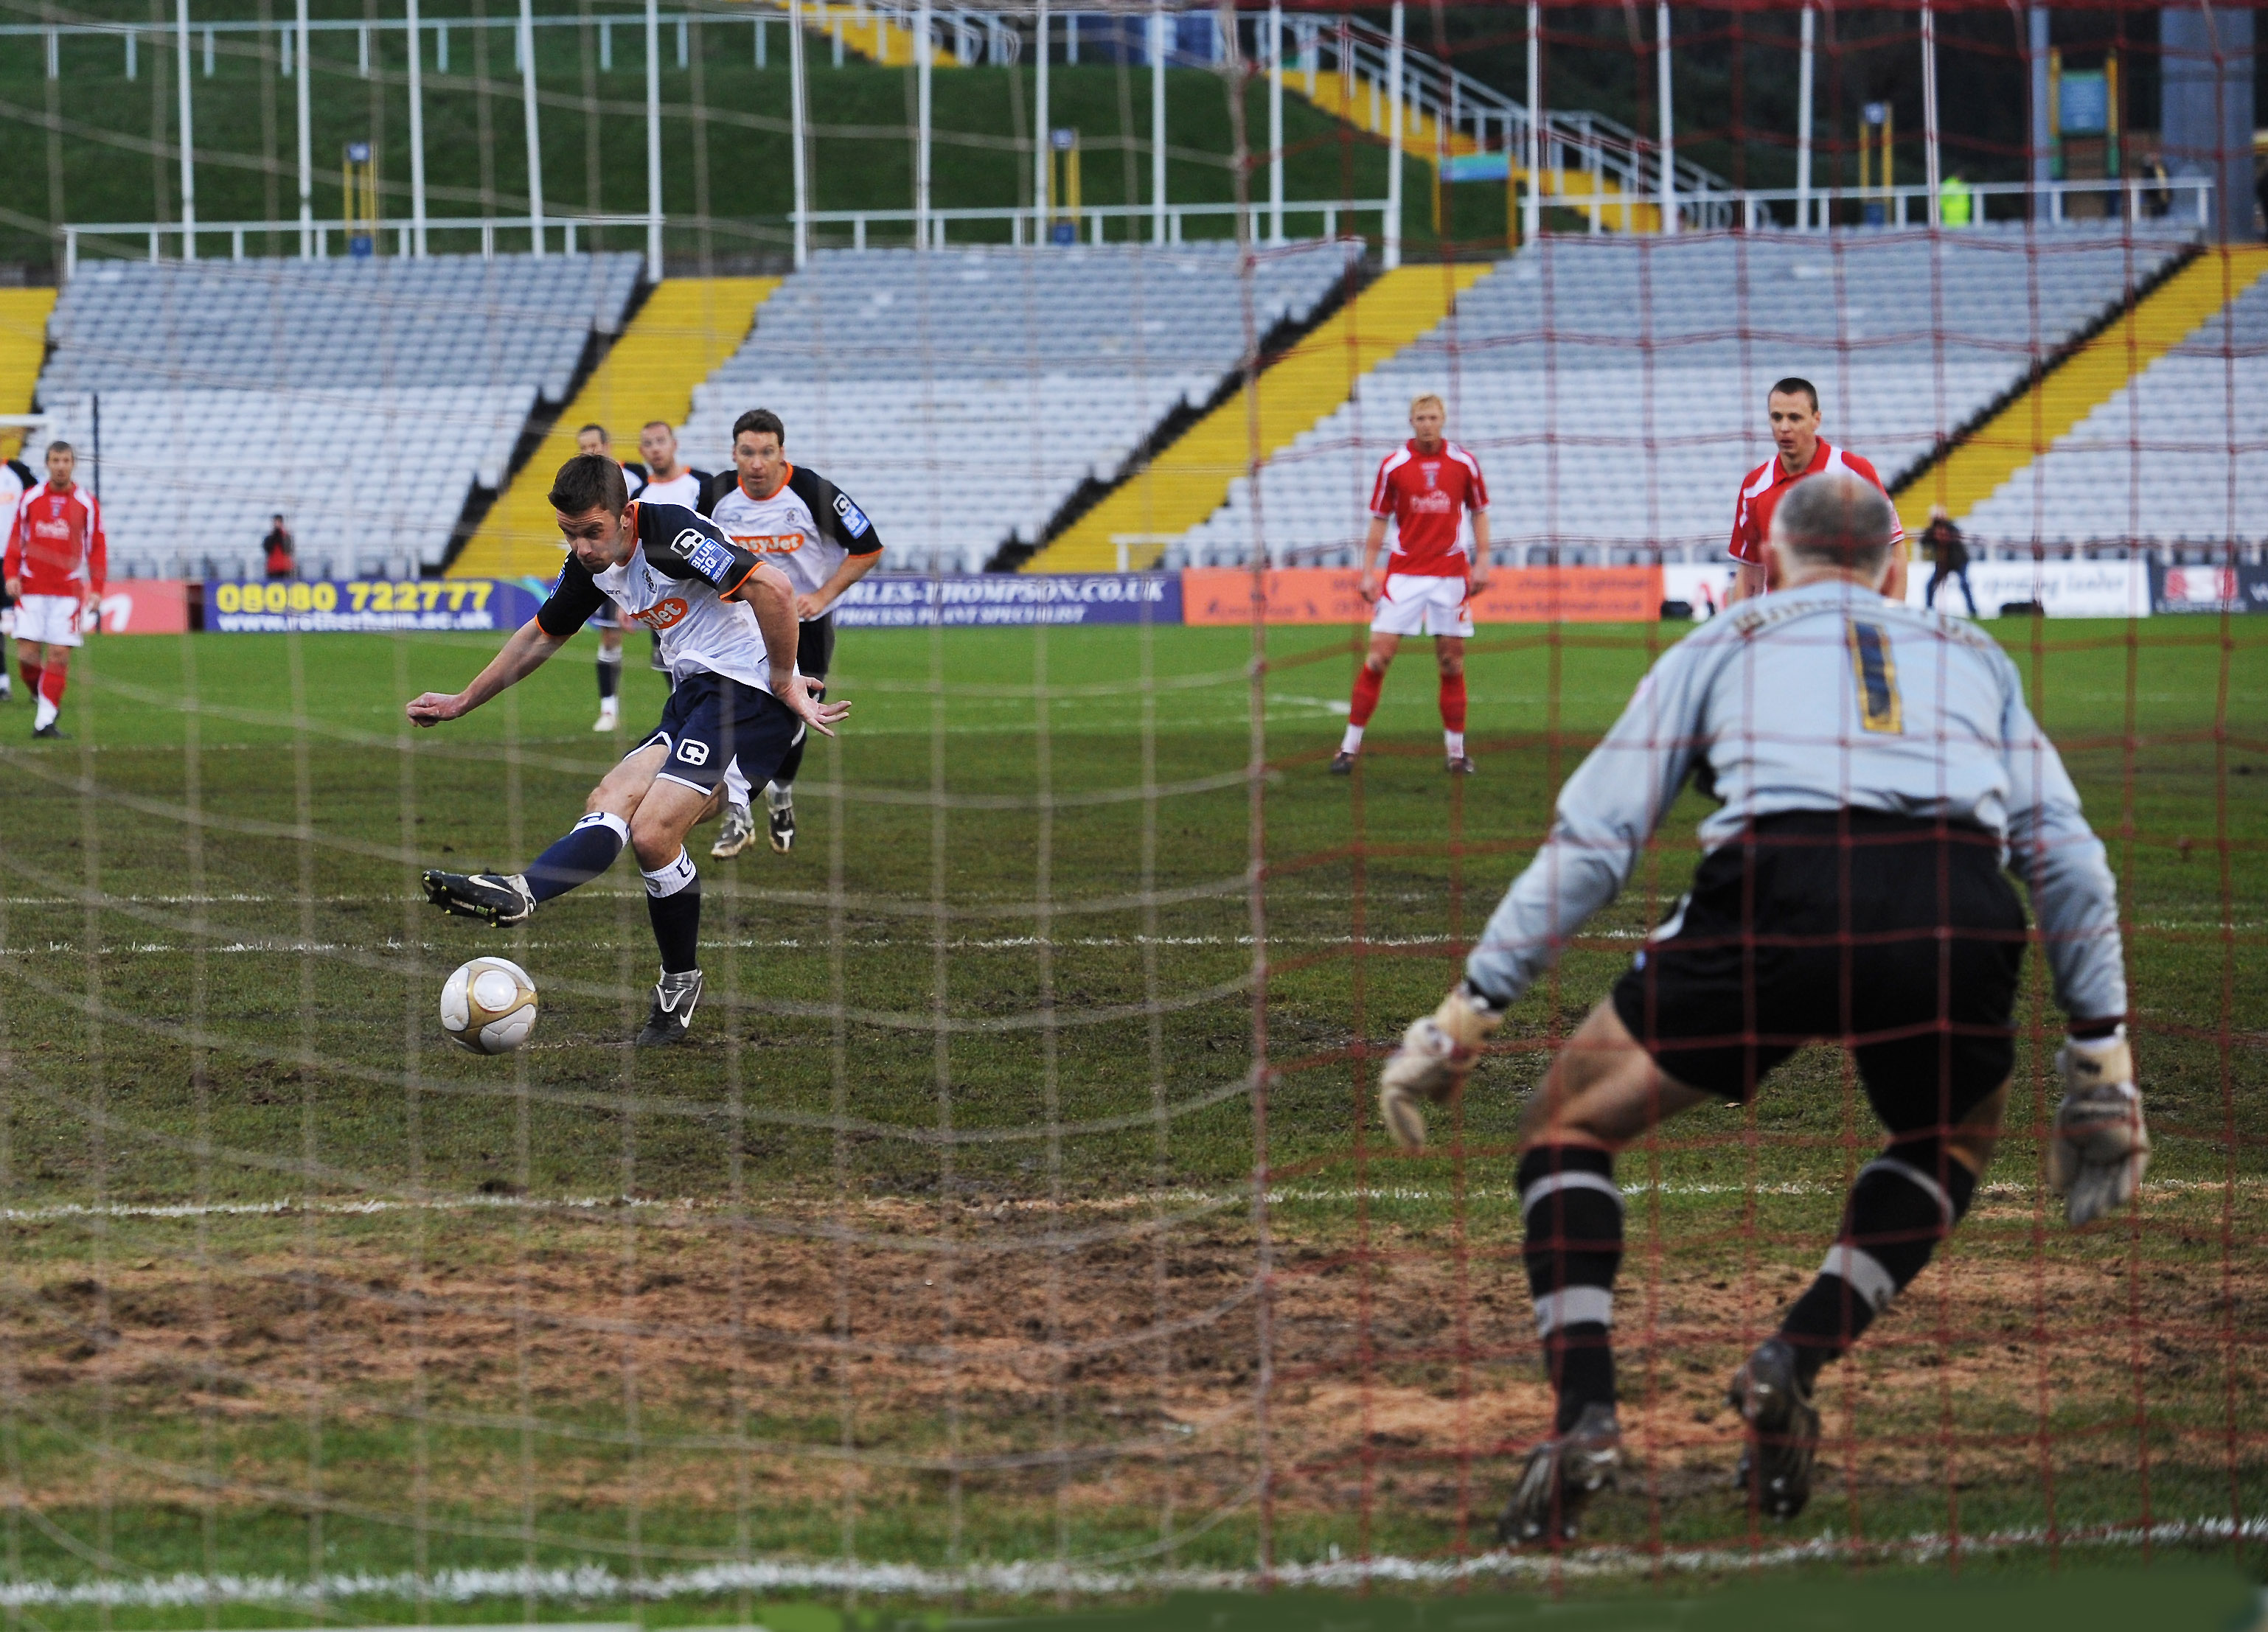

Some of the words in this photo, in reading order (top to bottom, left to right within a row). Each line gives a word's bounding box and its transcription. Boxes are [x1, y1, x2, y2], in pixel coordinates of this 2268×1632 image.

[691, 541, 717, 569] BLUE
[738, 536, 799, 553] asyJet
[700, 557, 718, 576] SQ
[216, 582, 338, 613] 08080
[346, 582, 493, 612] 722777
[845, 579, 1166, 605] RLES-THOMPSON.CO.UK
[637, 602, 682, 629] yJet
[1848, 617, 1902, 735] 1
